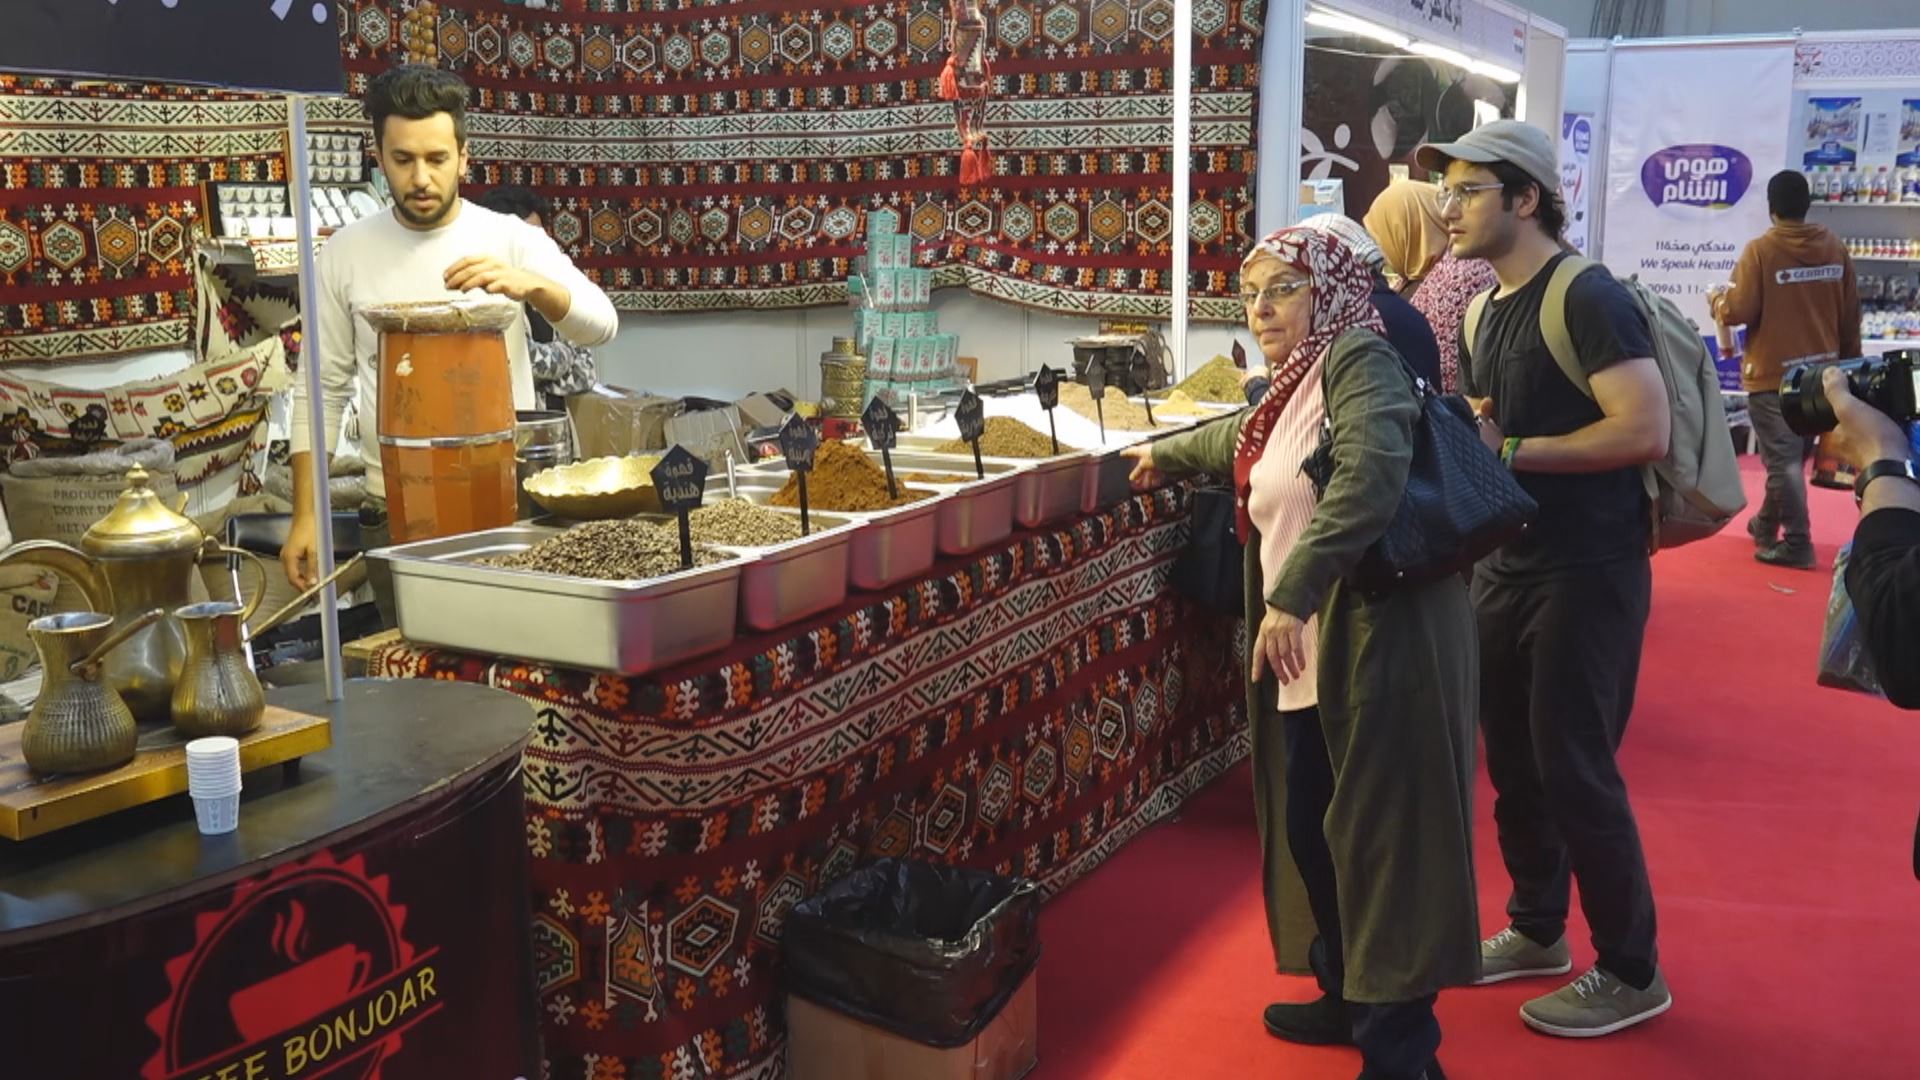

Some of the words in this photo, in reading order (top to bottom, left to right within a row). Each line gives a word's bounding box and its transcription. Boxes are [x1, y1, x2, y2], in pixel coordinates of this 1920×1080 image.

[1640, 259, 1659, 269] We
[1660, 258, 1695, 272] Speak
[665, 457, 694, 478] قهوة
[662, 480, 700, 504] هندية
[283, 966, 438, 1076] BONJOAR
